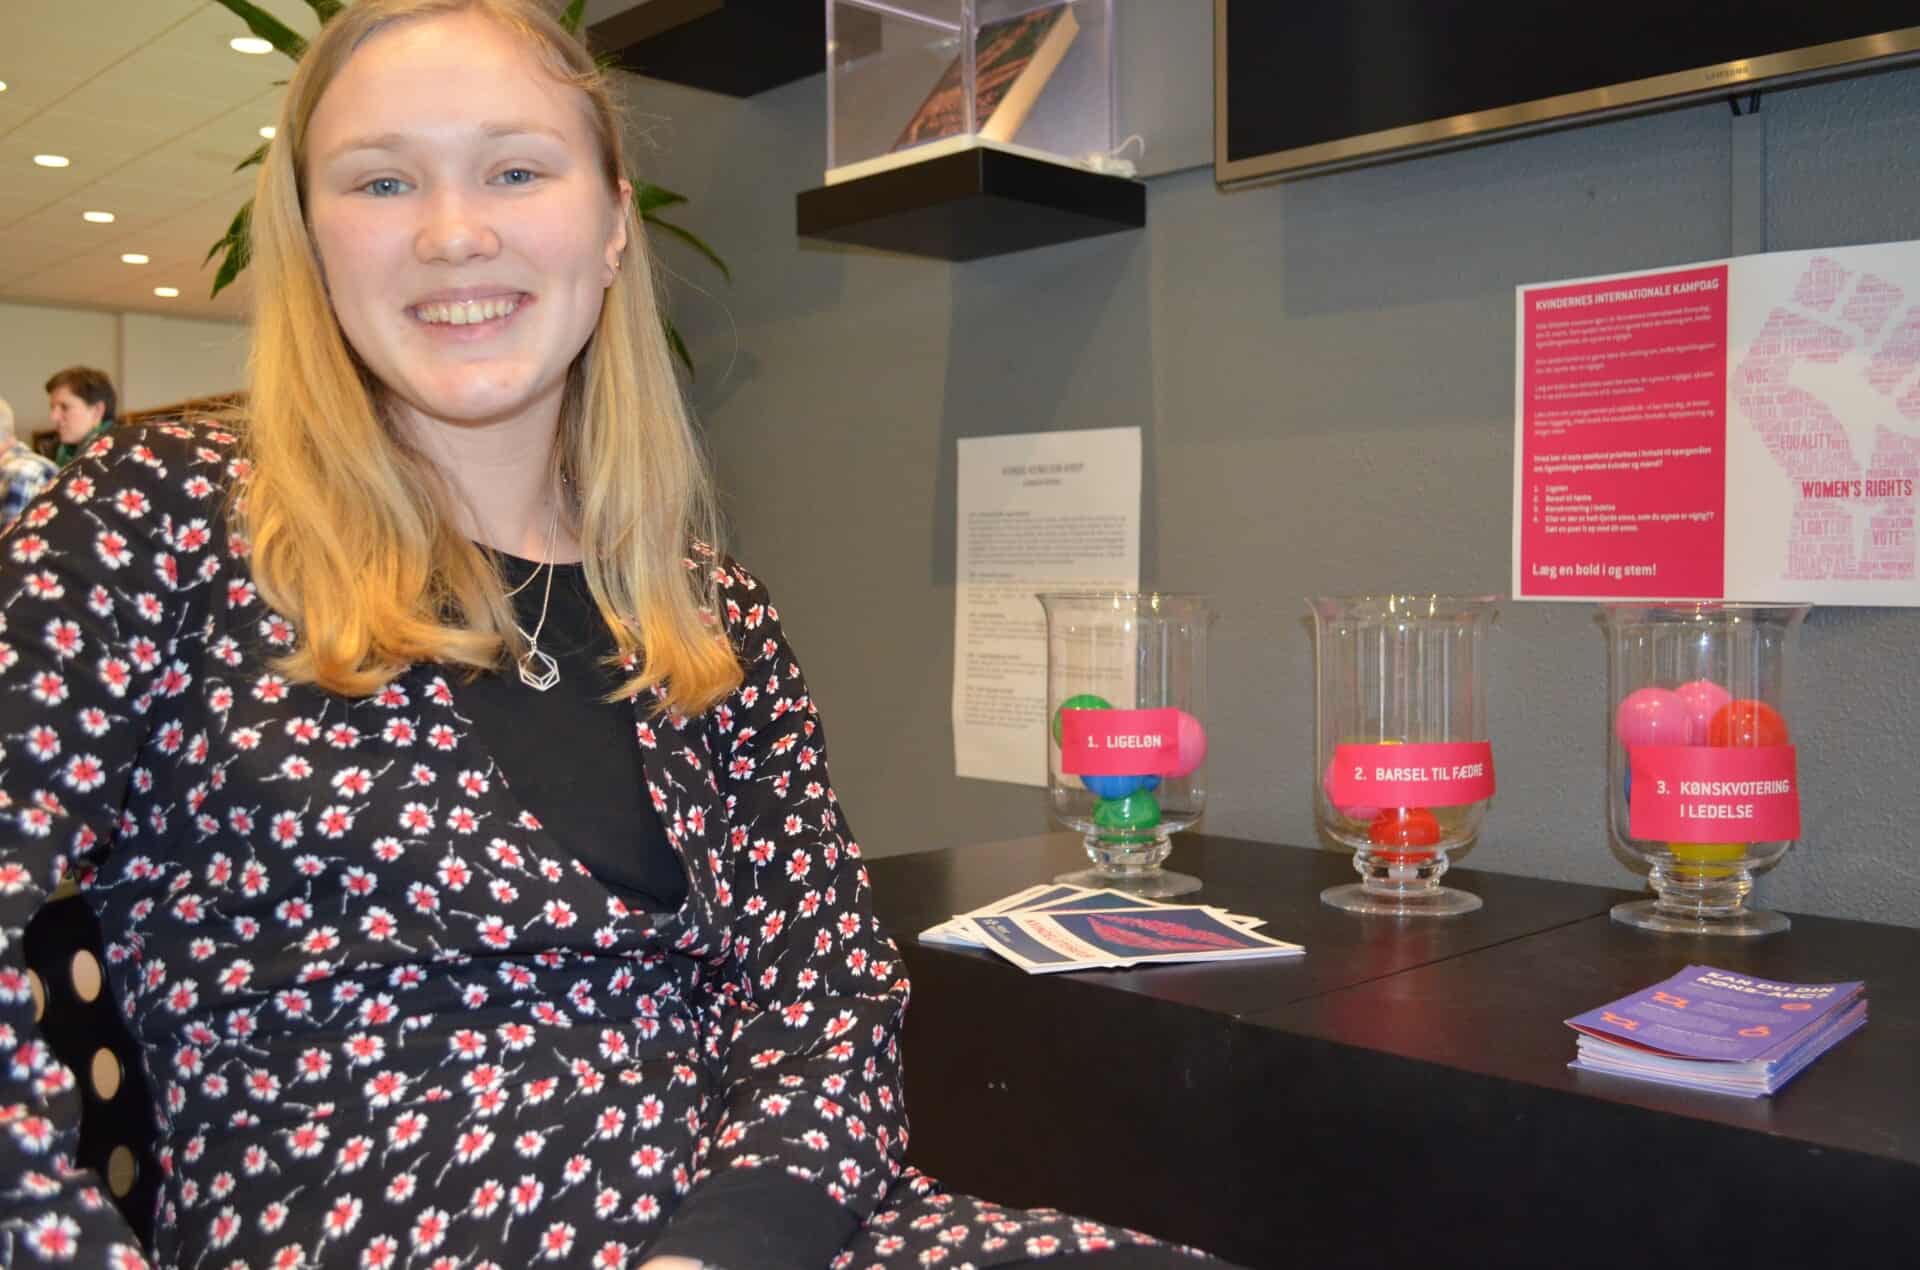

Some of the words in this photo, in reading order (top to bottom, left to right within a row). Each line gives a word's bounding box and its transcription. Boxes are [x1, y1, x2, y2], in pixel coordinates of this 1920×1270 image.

[1535, 294, 1593, 312] KVINDERNES
[1594, 284, 1671, 305] INTERNATIONALE
[1673, 278, 1720, 295] KAMPDAG
[1802, 480, 1862, 498] WOMEN'S
[1865, 479, 1912, 497] RIGHTS
[1532, 563, 1557, 580] Læg
[1559, 566, 1574, 576] en
[1576, 563, 1600, 577] bold
[1608, 566, 1622, 579] og
[1624, 563, 1657, 577] stem!
[1087, 735, 1099, 749] 1.
[1106, 735, 1162, 749] LIGELØN
[1354, 767, 1367, 781] 2.
[1375, 767, 1429, 782] BARSEL
[1431, 767, 1450, 781] TIL
[1452, 763, 1484, 779] FÆDRE
[1656, 780, 1671, 795] 3.
[1680, 779, 1790, 796] KØNSKVOTERING
[1680, 804, 1684, 818] I
[1688, 804, 1753, 819] LEDELSE
[1706, 972, 1753, 986] KAN
[1756, 983, 1791, 991] DU
